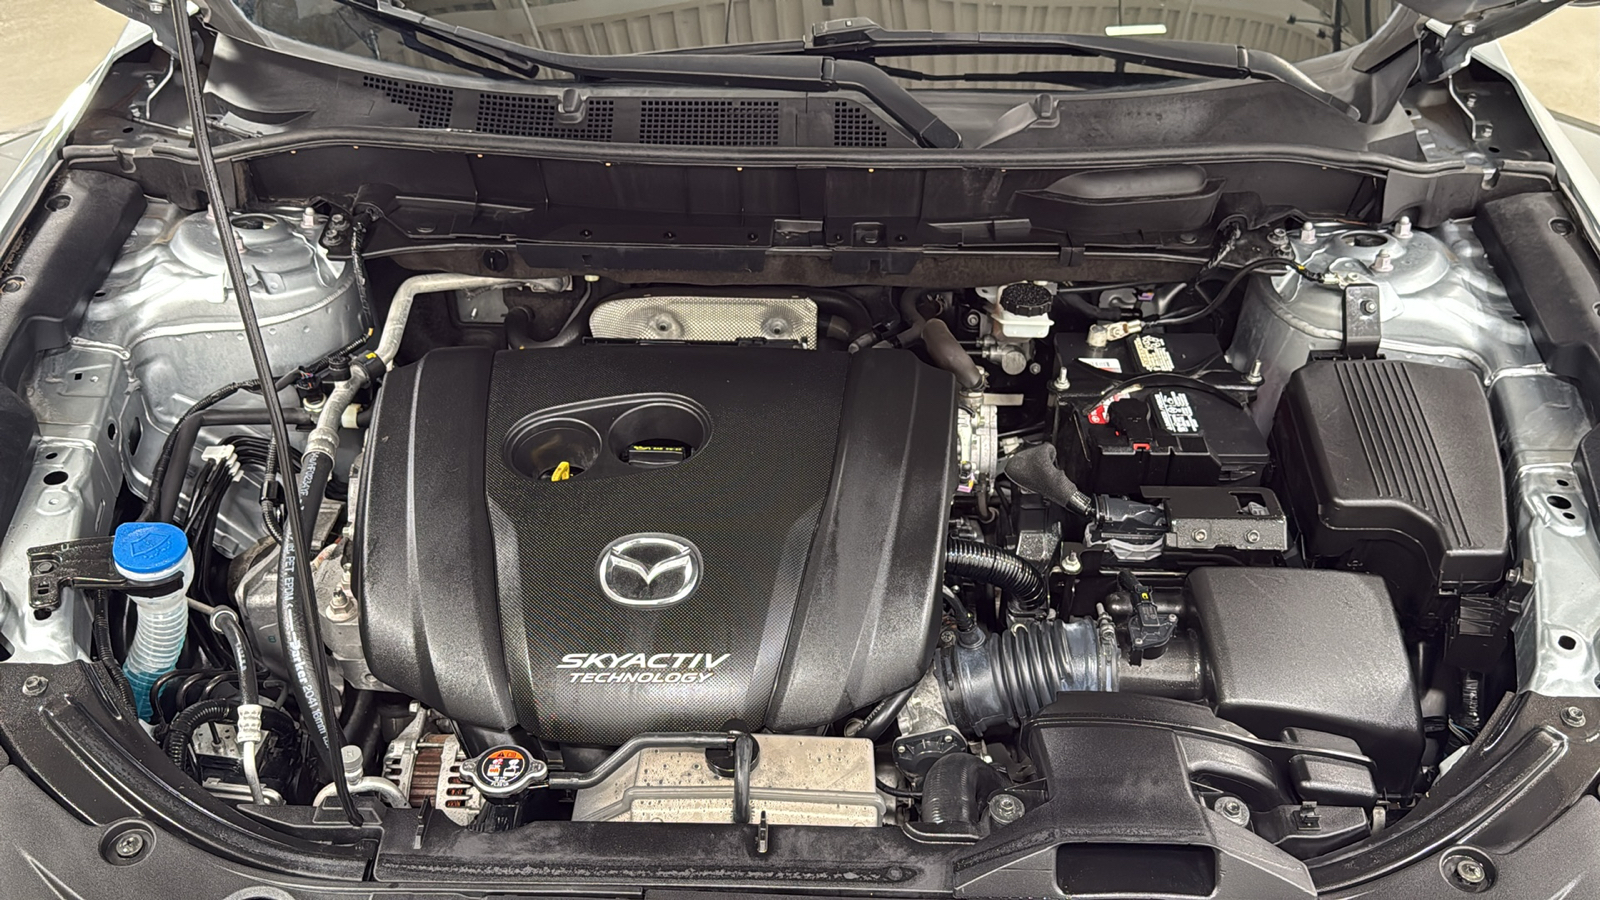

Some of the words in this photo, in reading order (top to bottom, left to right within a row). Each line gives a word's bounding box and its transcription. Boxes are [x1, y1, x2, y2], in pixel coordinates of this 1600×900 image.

[556, 653, 731, 669] SKYACTIV
[570, 672, 714, 683] TECHNOLOGY
[290, 639, 308, 684] Parker
[303, 684, 319, 708] 2041
[312, 708, 327, 735] 16mm
